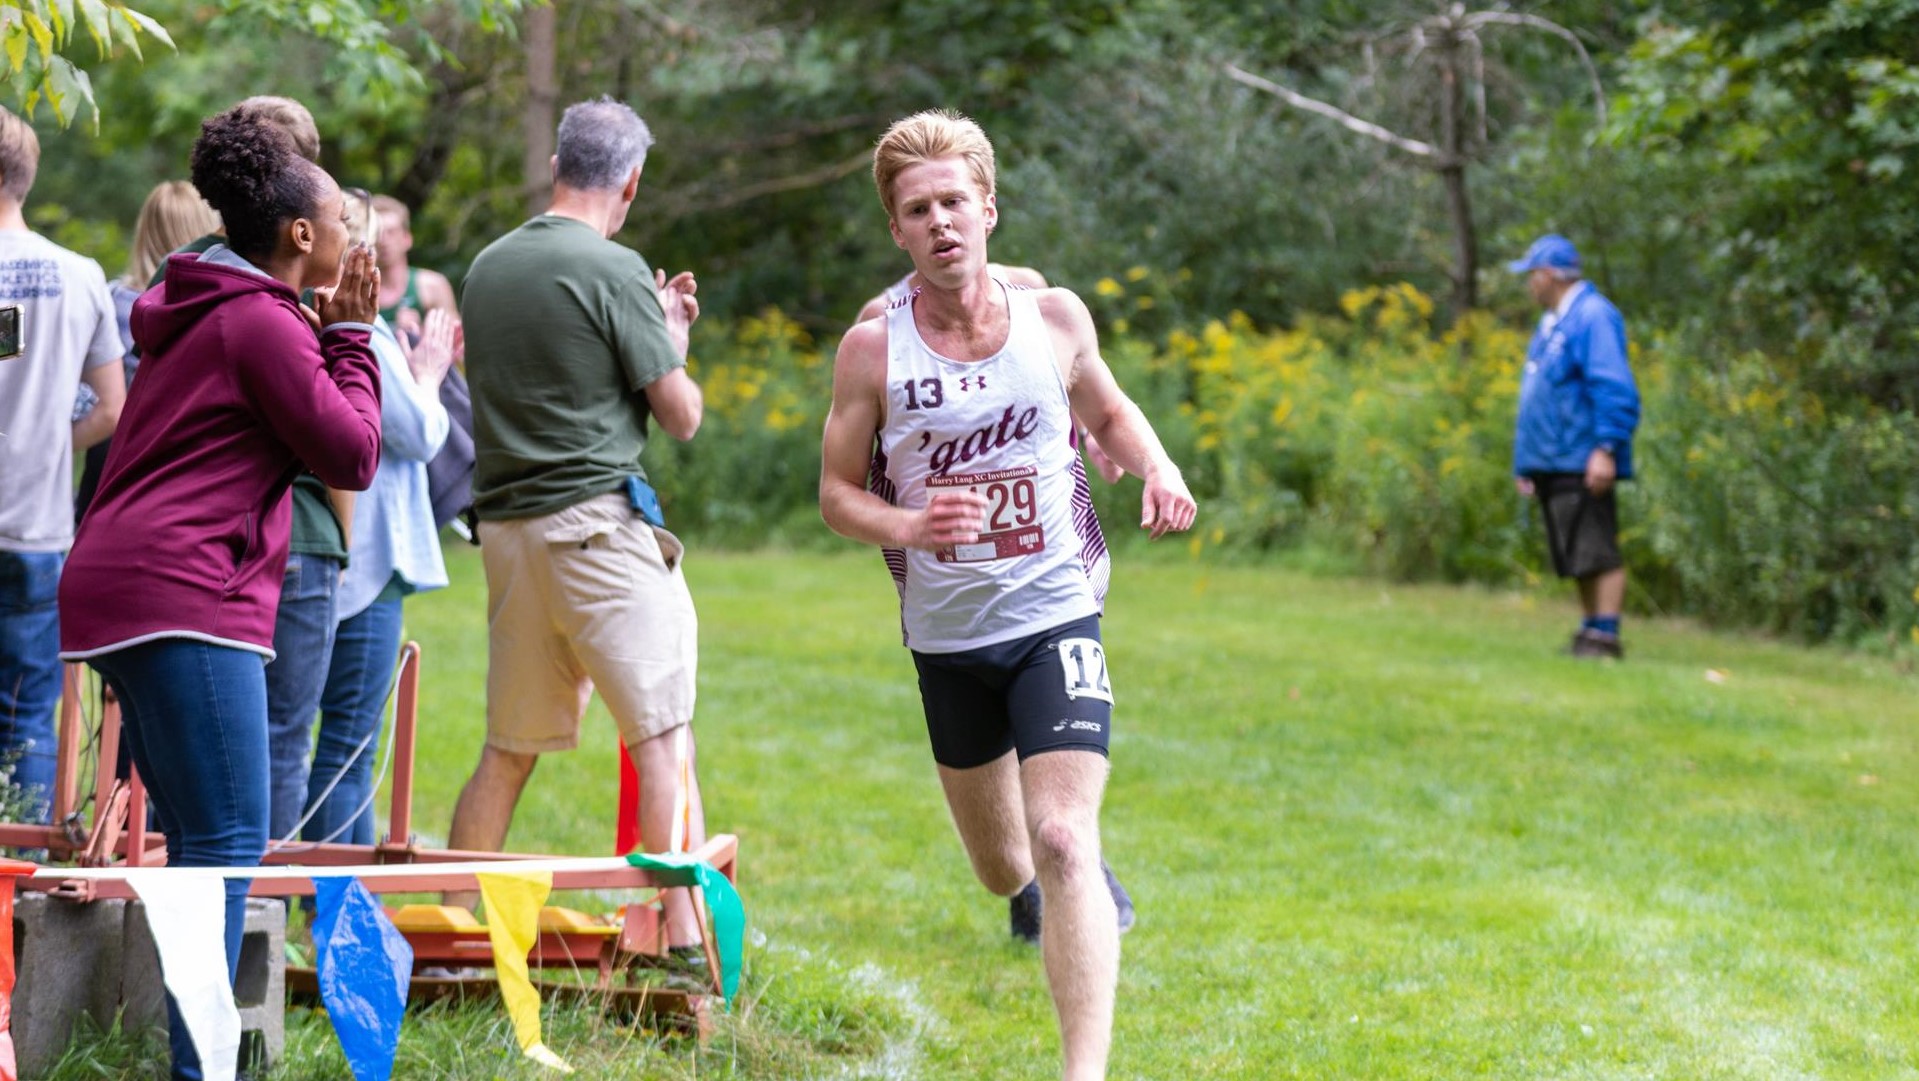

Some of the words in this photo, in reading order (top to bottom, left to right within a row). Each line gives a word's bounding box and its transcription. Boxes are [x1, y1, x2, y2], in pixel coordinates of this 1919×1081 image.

[904, 378, 943, 411] 13
[931, 476, 953, 486] Harry
[954, 475, 975, 486] Lang
[974, 473, 988, 483] XC
[970, 479, 1037, 531] 29
[1069, 644, 1110, 694] 12
